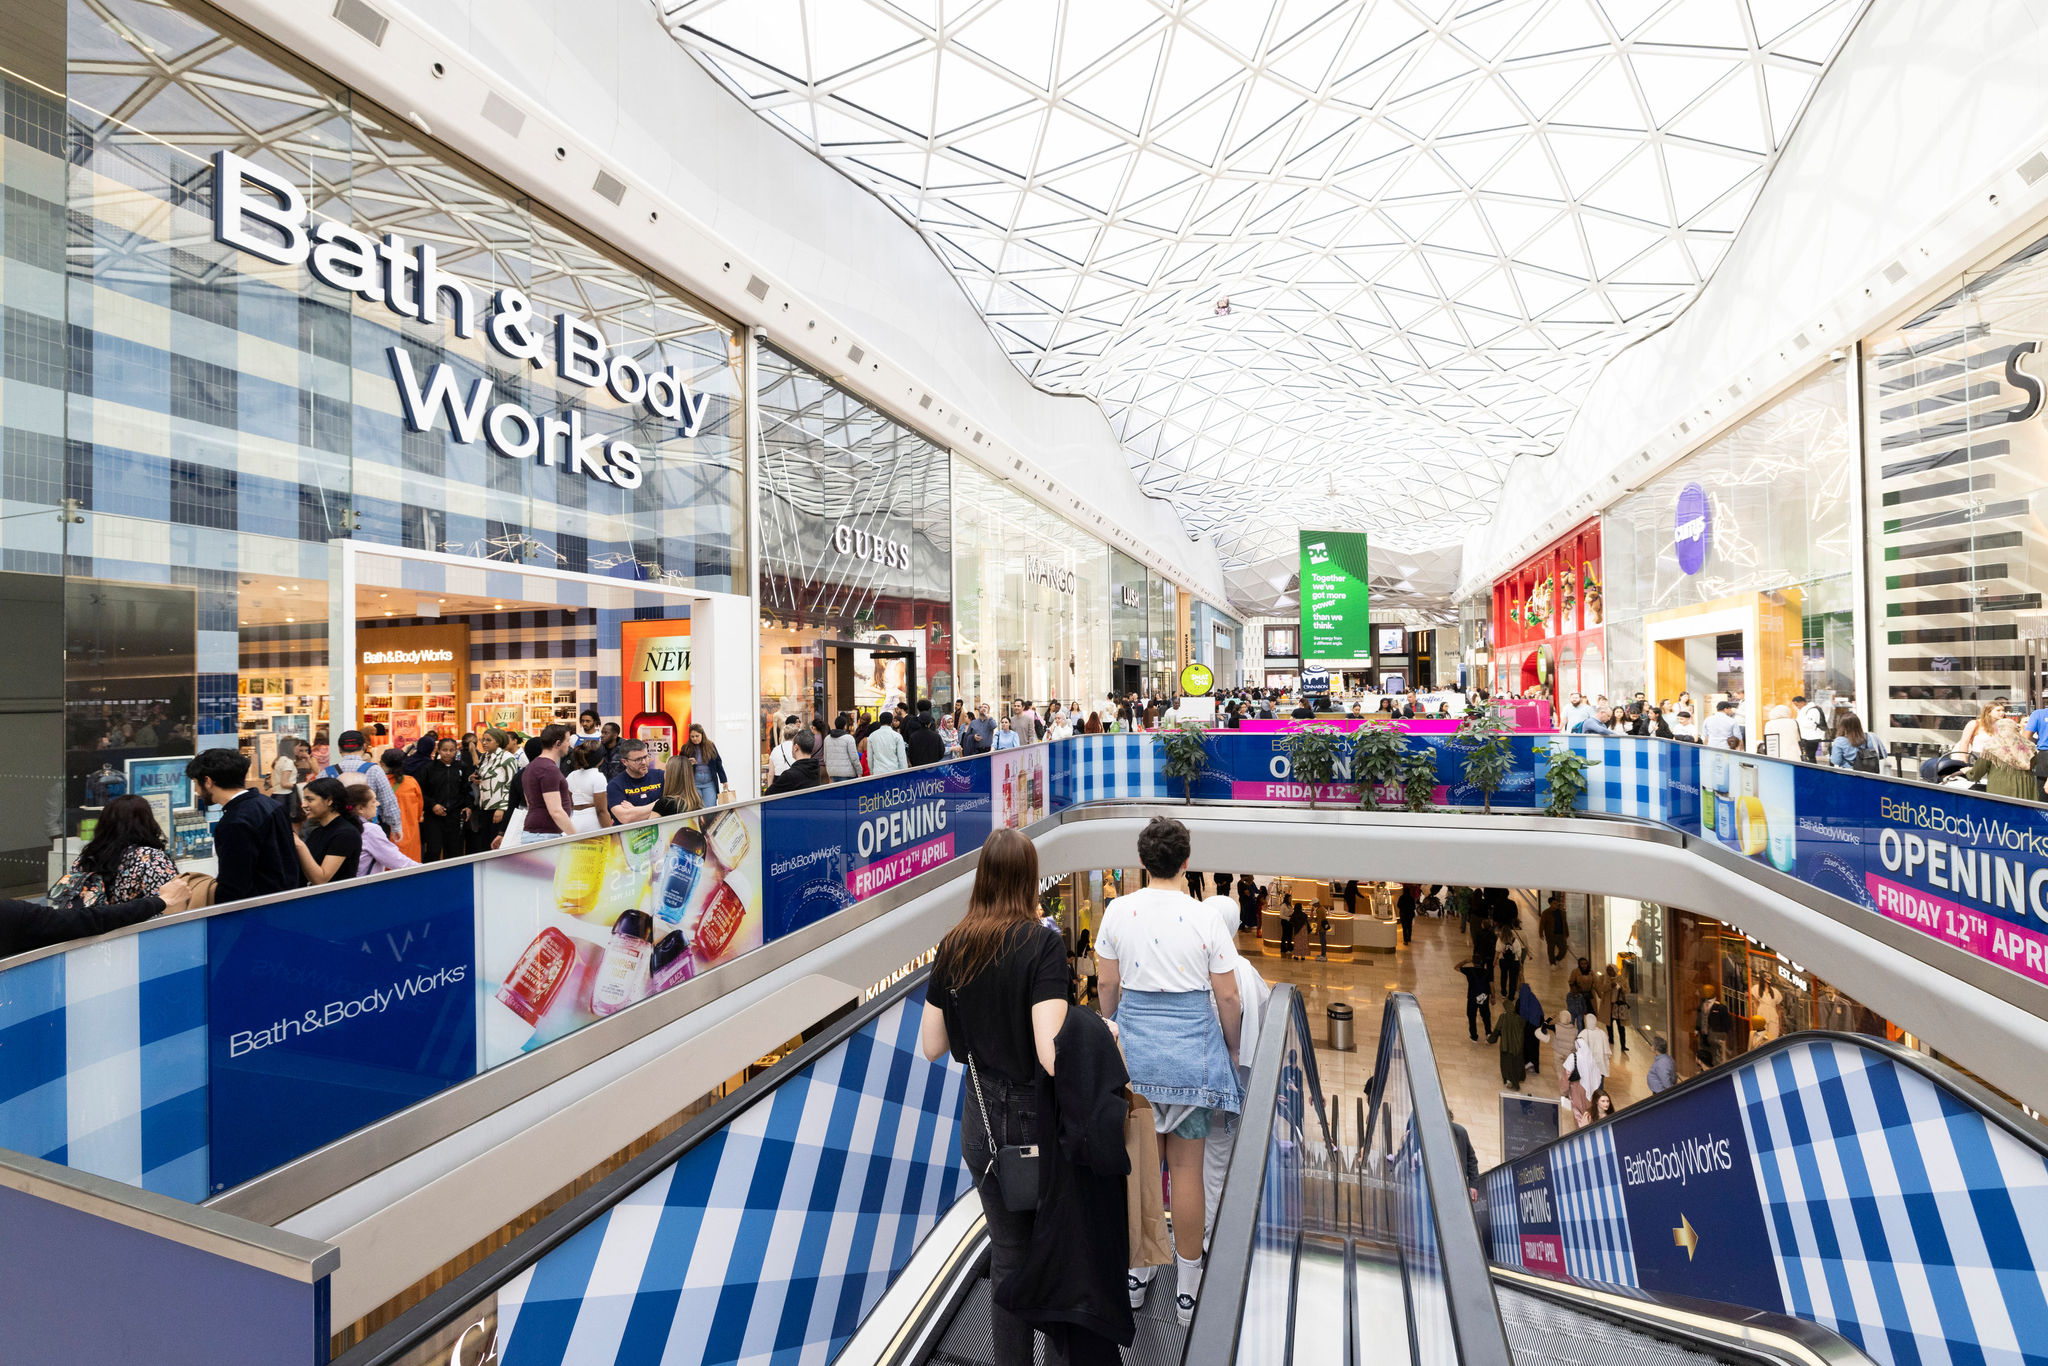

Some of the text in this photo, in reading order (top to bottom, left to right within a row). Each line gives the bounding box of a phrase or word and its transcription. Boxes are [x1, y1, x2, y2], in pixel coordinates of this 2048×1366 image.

[214, 149, 475, 340] Bath
[556, 313, 711, 437] Body
[387, 345, 643, 491] Works
[833, 523, 910, 571] GUESS
[1024, 553, 1076, 596] MANGO
[1311, 573, 1346, 583] Together
[1312, 583, 1335, 591] we've
[1312, 592, 1346, 601] got more
[1312, 599, 1336, 613] power
[1312, 612, 1343, 621] than we
[1313, 621, 1335, 630] think.
[495, 711, 518, 721] NEW
[396, 719, 417, 728] NEW
[140, 772, 181, 786] NEW
[1265, 784, 1323, 799] FRIDAY
[857, 798, 947, 859] OPENING
[856, 866, 898, 896] FRIDAY
[920, 841, 948, 868] APRIL
[1878, 883, 1942, 930] FRIDAY
[1519, 1187, 1552, 1224] OPENING
